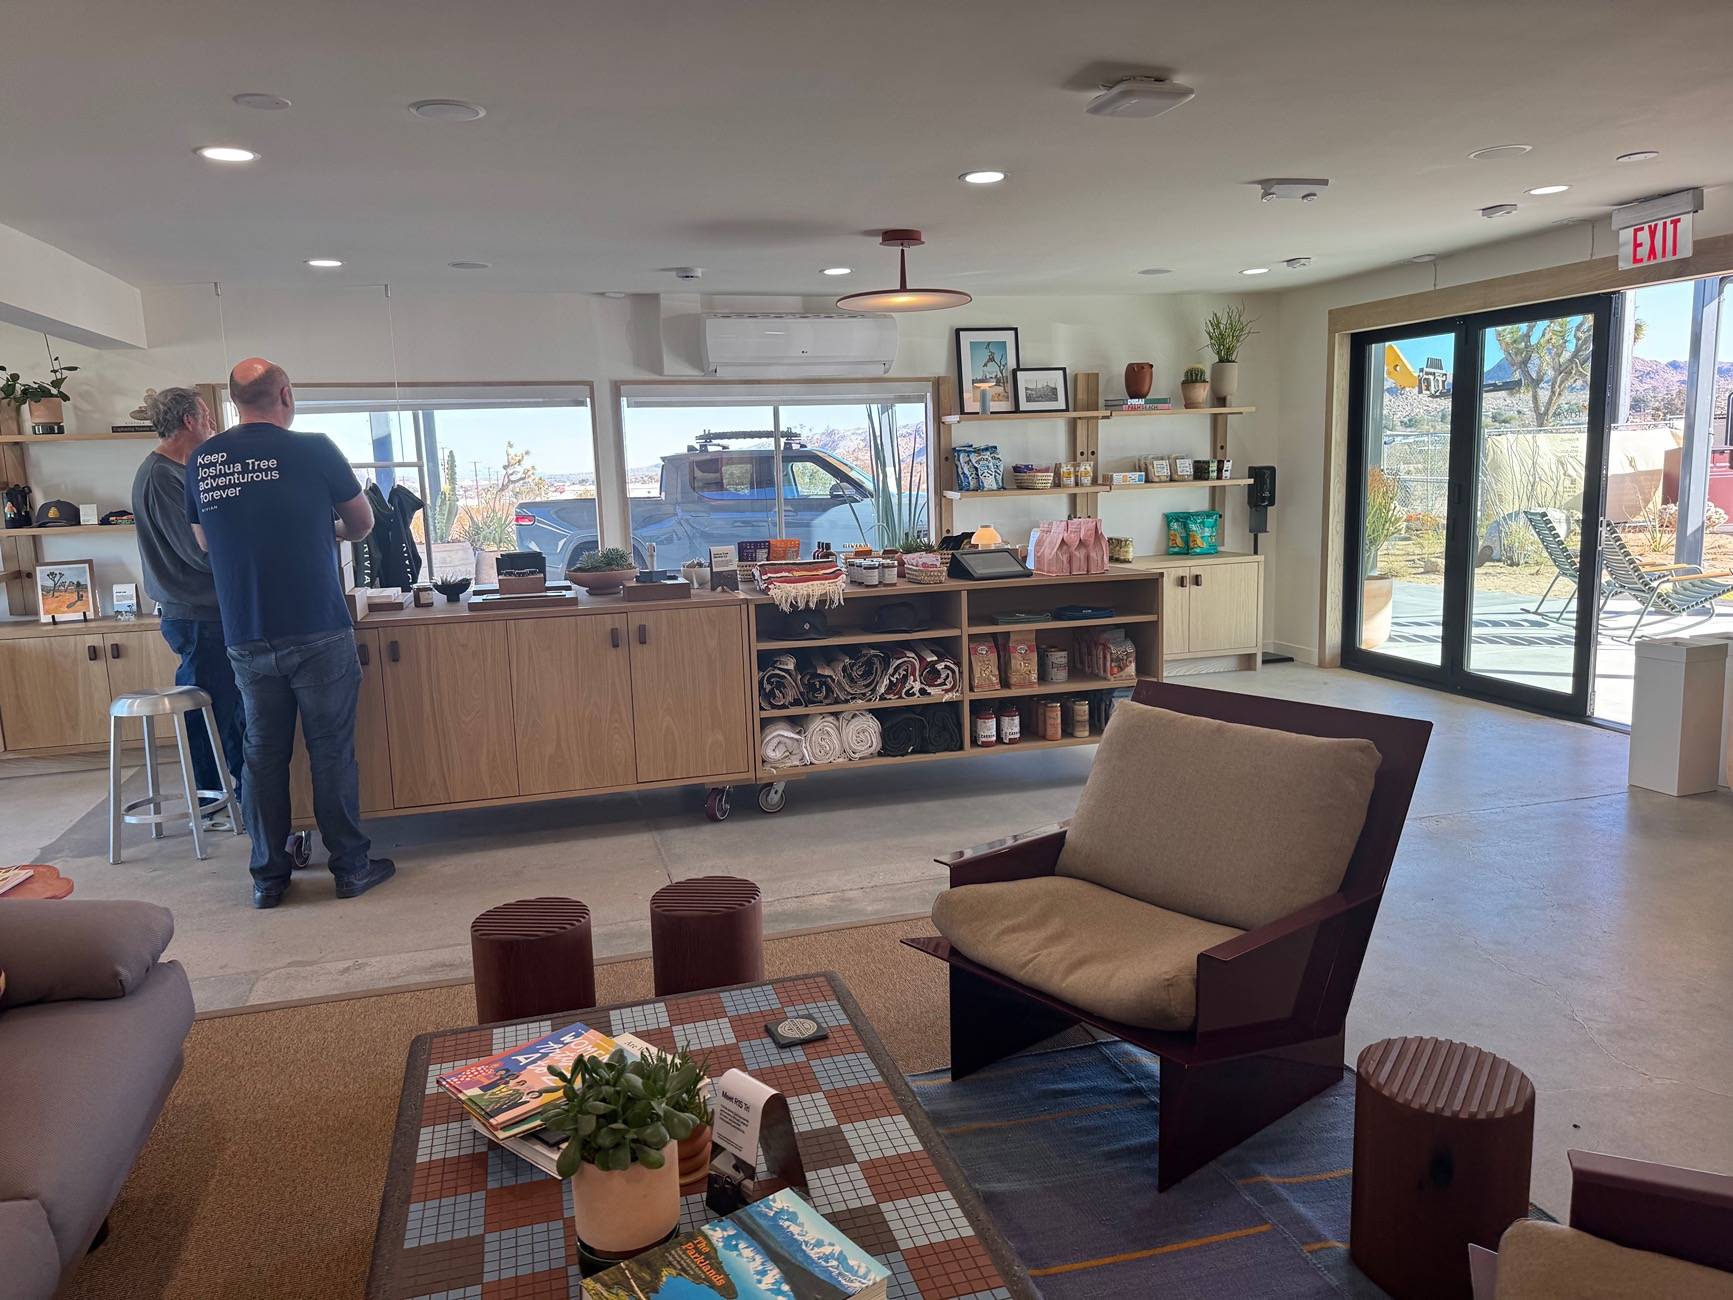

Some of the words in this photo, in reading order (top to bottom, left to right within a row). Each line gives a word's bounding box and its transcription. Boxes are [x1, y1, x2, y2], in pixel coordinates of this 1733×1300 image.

[1632, 217, 1681, 265] EXIT
[197, 452, 227, 466] Keep
[198, 463, 242, 479] Joshua
[246, 459, 278, 470] Tree
[199, 470, 280, 491] adventurous
[200, 486, 242, 503] forever
[363, 543, 371, 584] RIVIA
[512, 1053, 542, 1066] A
[721, 1090, 735, 1104] Meet
[694, 1236, 711, 1253] The
[680, 1242, 726, 1287] Parklands
